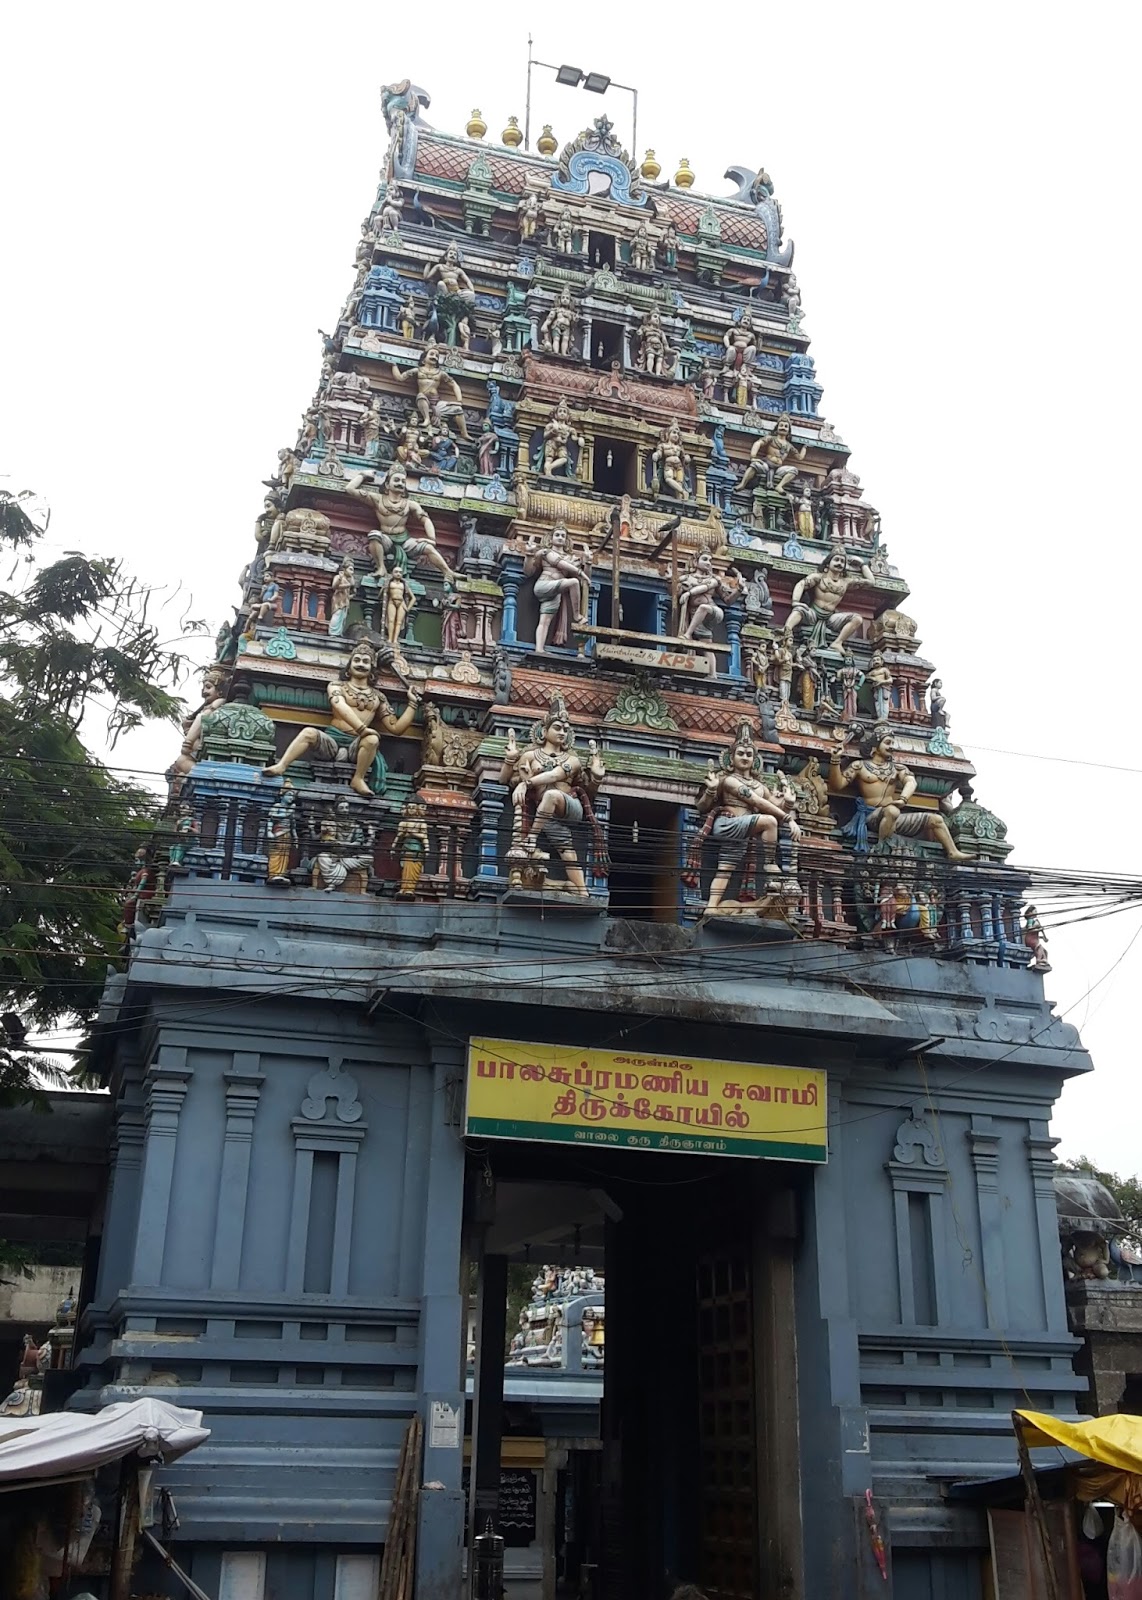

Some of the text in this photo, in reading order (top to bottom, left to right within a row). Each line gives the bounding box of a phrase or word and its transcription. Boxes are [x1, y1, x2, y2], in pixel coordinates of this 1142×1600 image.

[658, 652, 696, 670] KPS
[612, 1056, 693, 1071] அருள்மிகு
[476, 1060, 818, 1107] பாலசுப்ரமணிய சுவாமி
[551, 1088, 750, 1128] திருக்கோயில்
